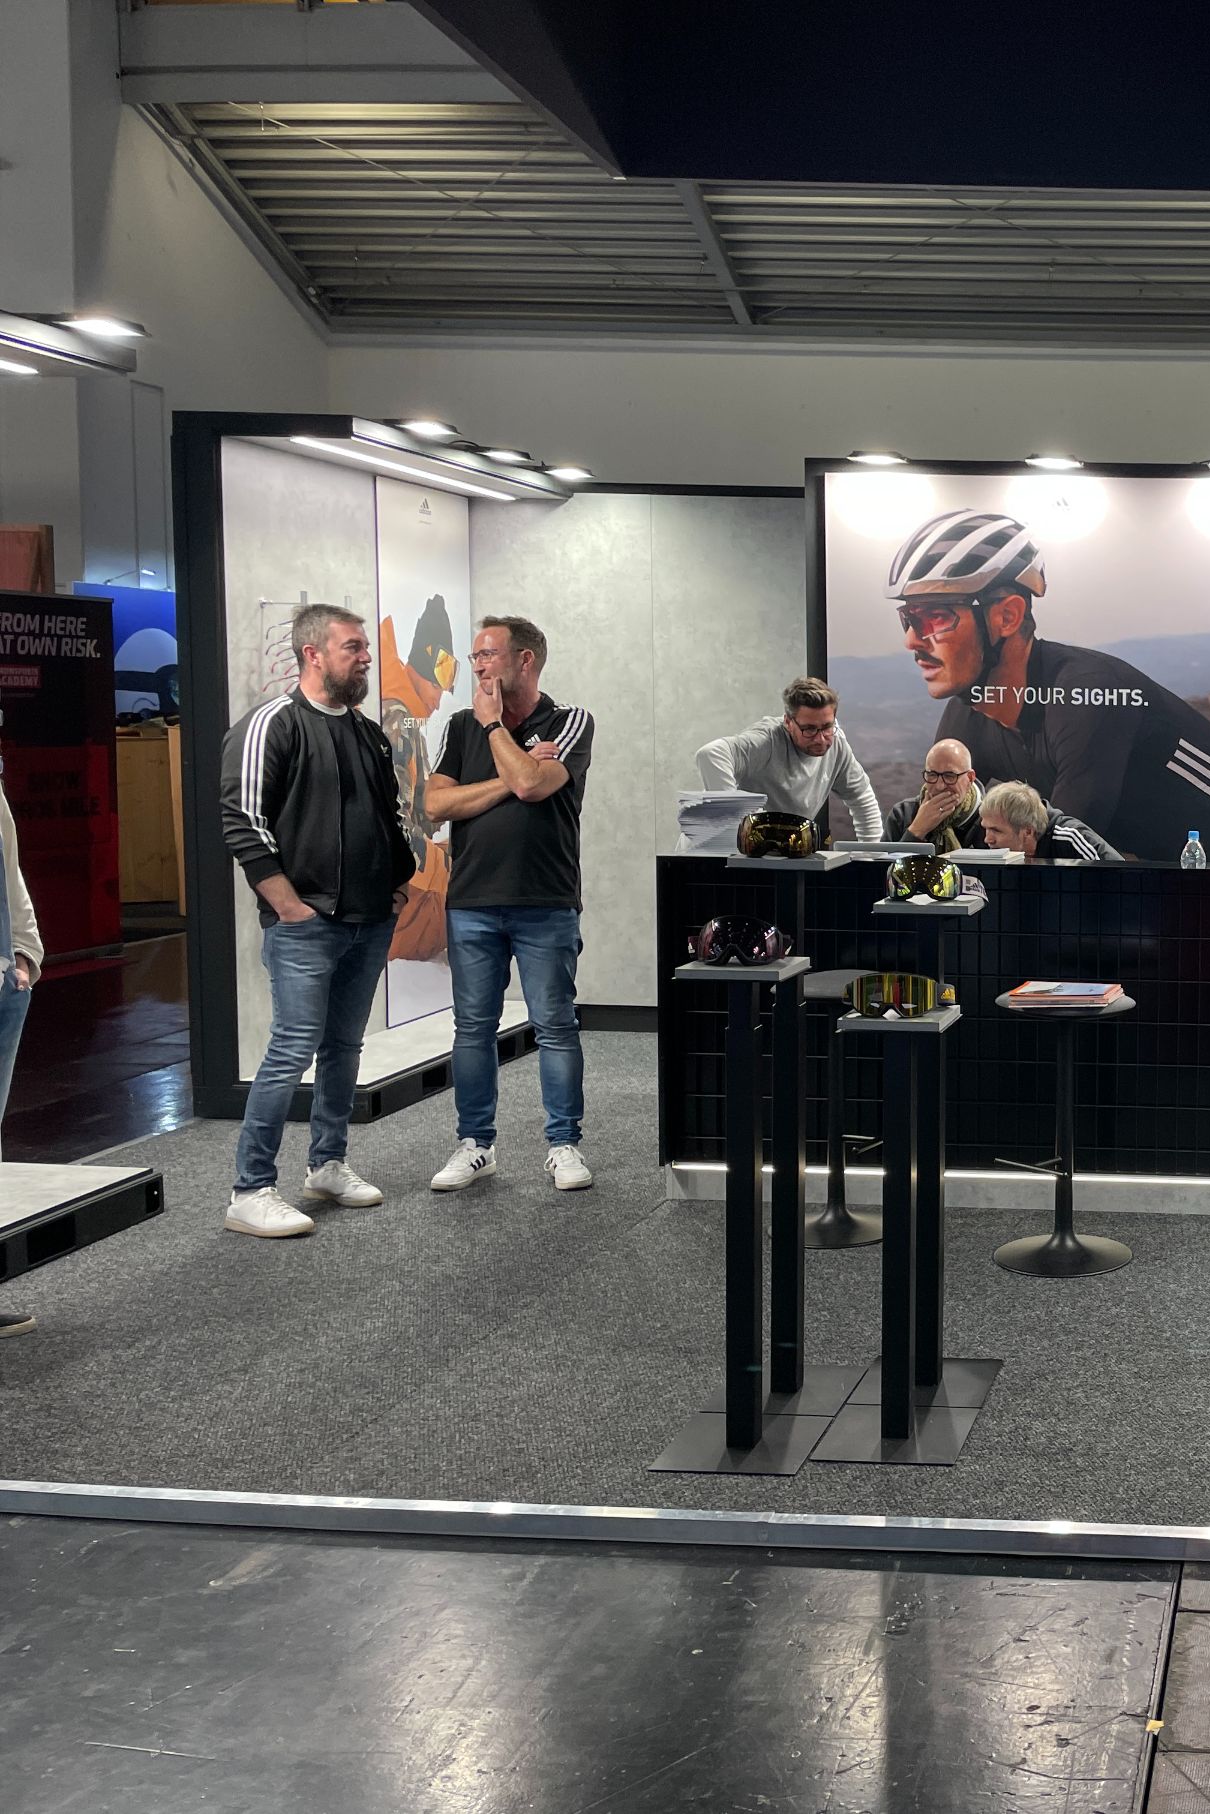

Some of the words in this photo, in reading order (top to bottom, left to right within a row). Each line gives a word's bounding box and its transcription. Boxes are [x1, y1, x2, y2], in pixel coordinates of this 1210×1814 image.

[0, 611, 40, 633] ROM
[44, 614, 87, 636] HERE
[16, 635, 58, 657] OWN
[61, 637, 101, 658] RISK.
[0, 675, 38, 687] CADEMY
[970, 686, 1007, 704] SET
[1012, 686, 1065, 705] YOUR
[1070, 688, 1149, 707] SIGHTS.
[403, 717, 415, 729] SET
